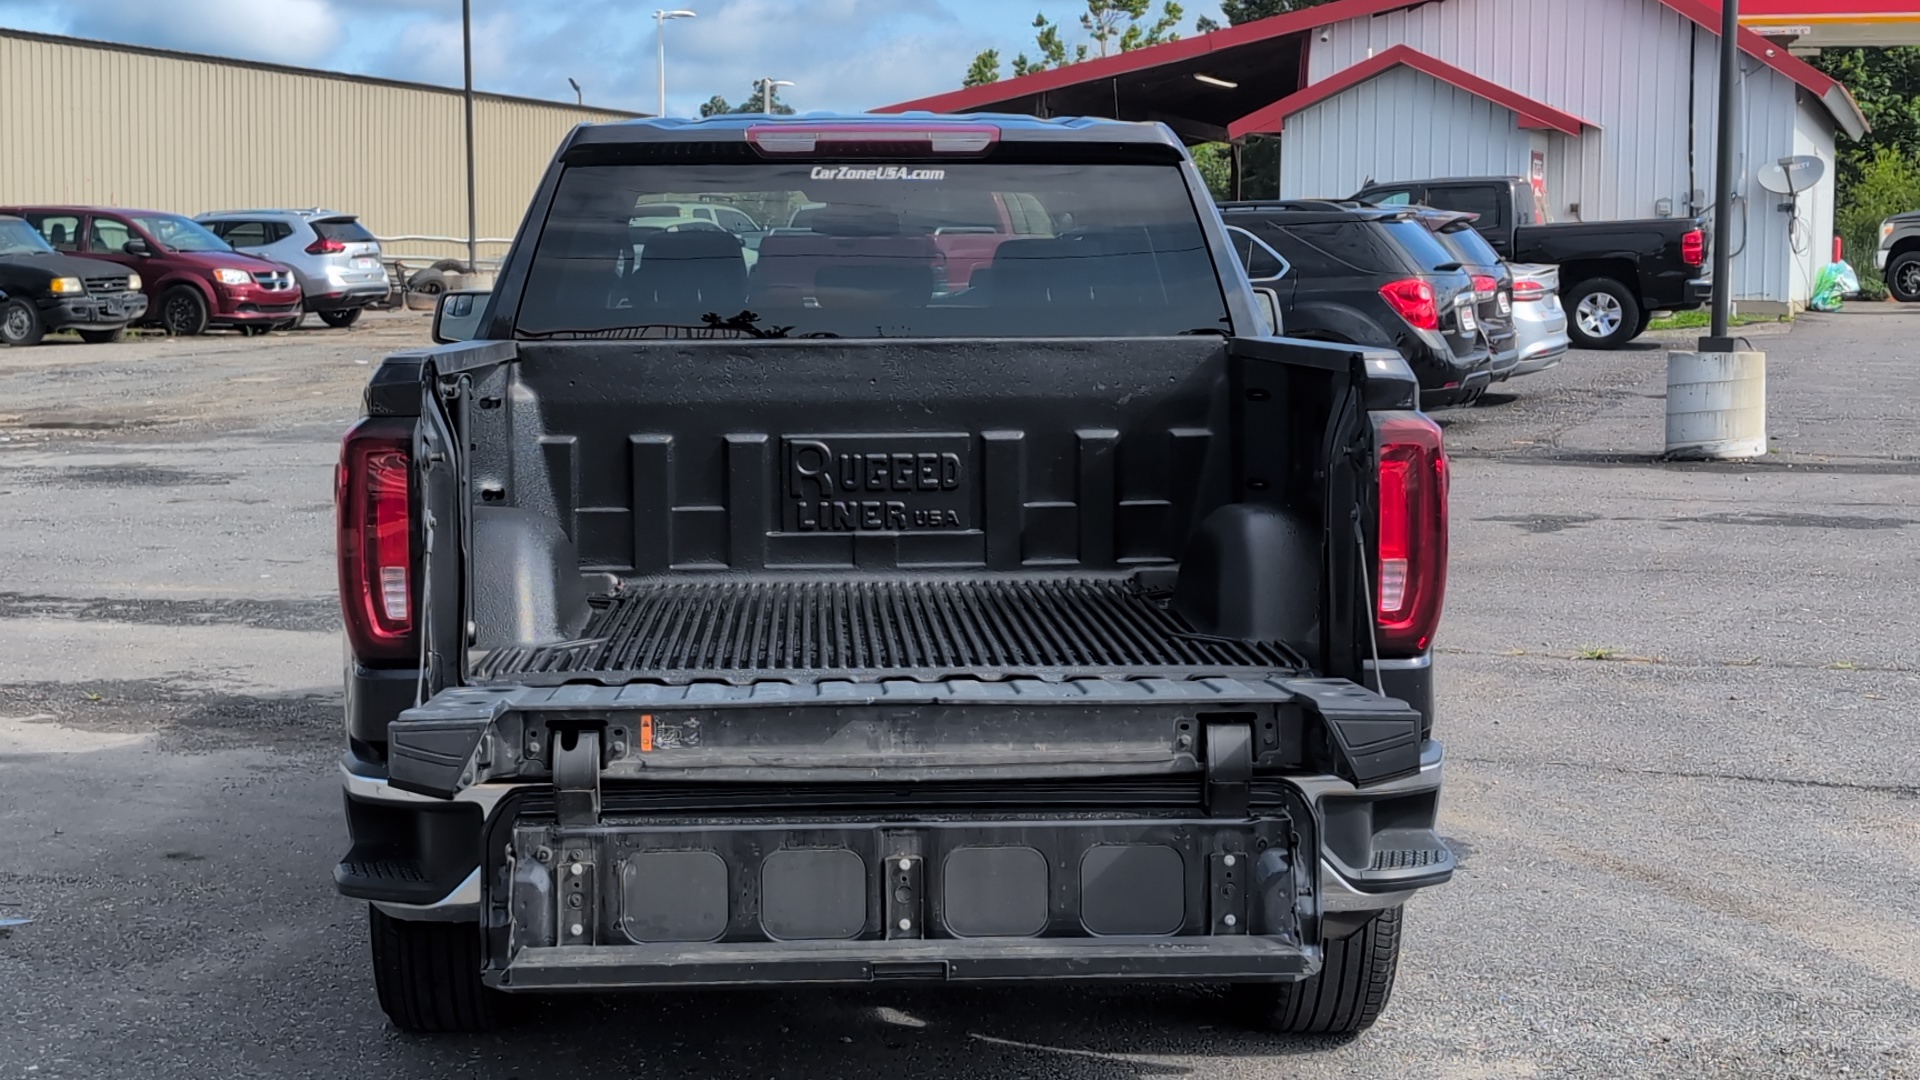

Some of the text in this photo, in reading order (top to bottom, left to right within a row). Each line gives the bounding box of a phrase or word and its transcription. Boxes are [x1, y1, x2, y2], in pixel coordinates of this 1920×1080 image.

[810, 166, 945, 180] CarZoneUSA.com
[789, 439, 961, 498] RUGGED
[797, 501, 960, 530] LINER USA
